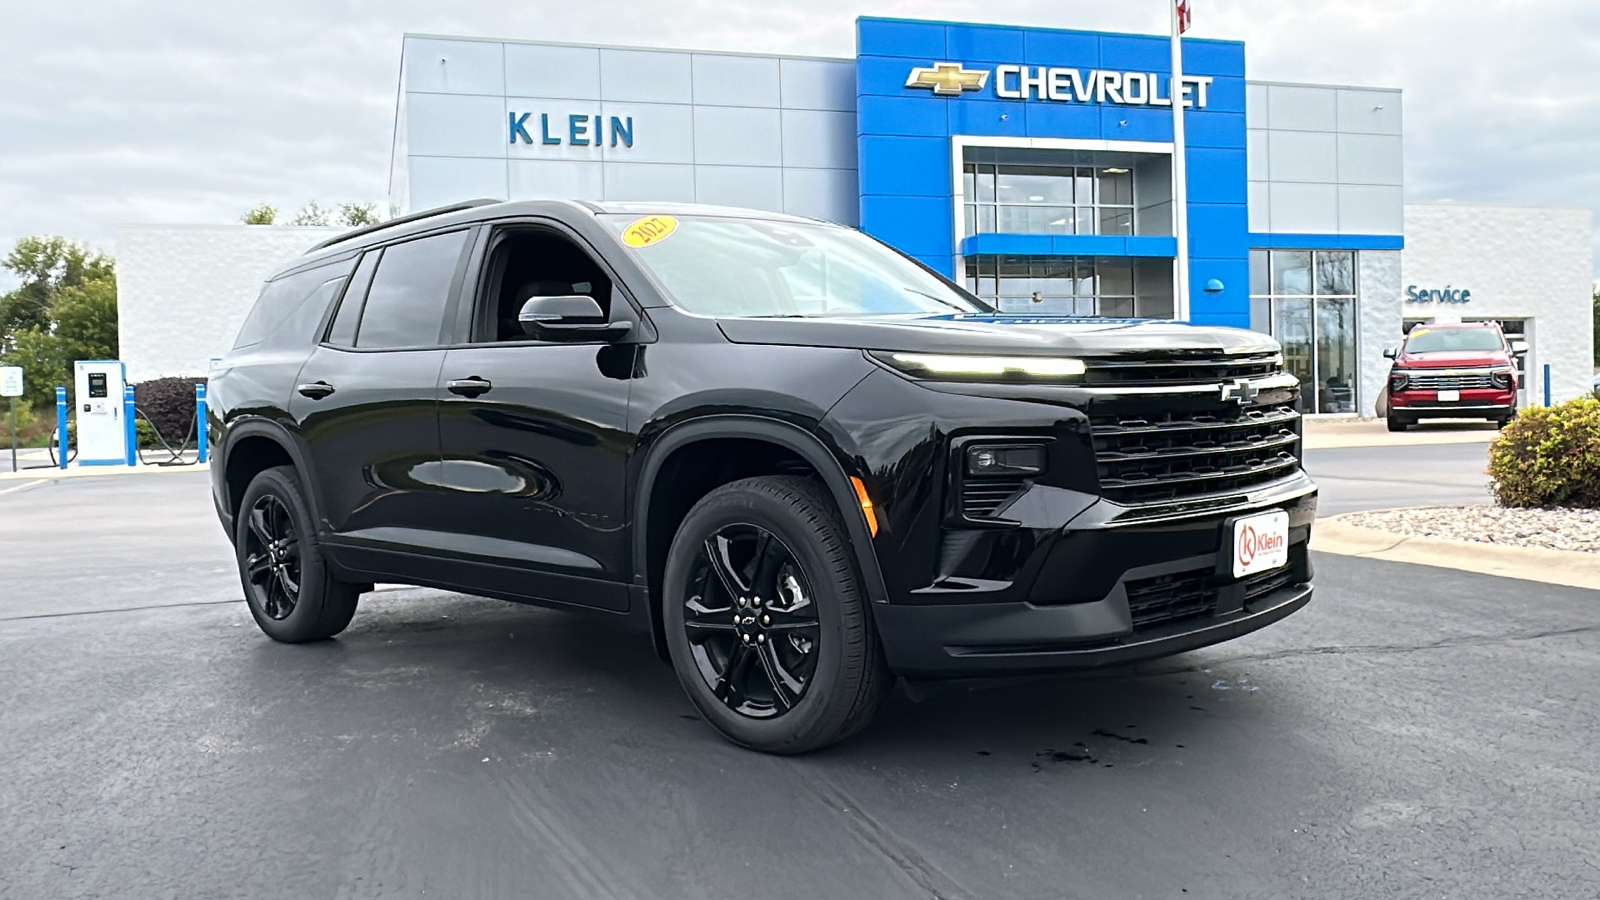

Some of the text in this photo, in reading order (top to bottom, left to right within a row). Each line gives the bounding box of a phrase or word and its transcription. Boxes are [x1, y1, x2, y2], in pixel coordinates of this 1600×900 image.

[996, 64, 1213, 107] CHEVROLET
[509, 111, 633, 148] KLEIN
[631, 217, 668, 244] 2027
[1405, 284, 1471, 303] Service
[1257, 531, 1283, 551] Klein
